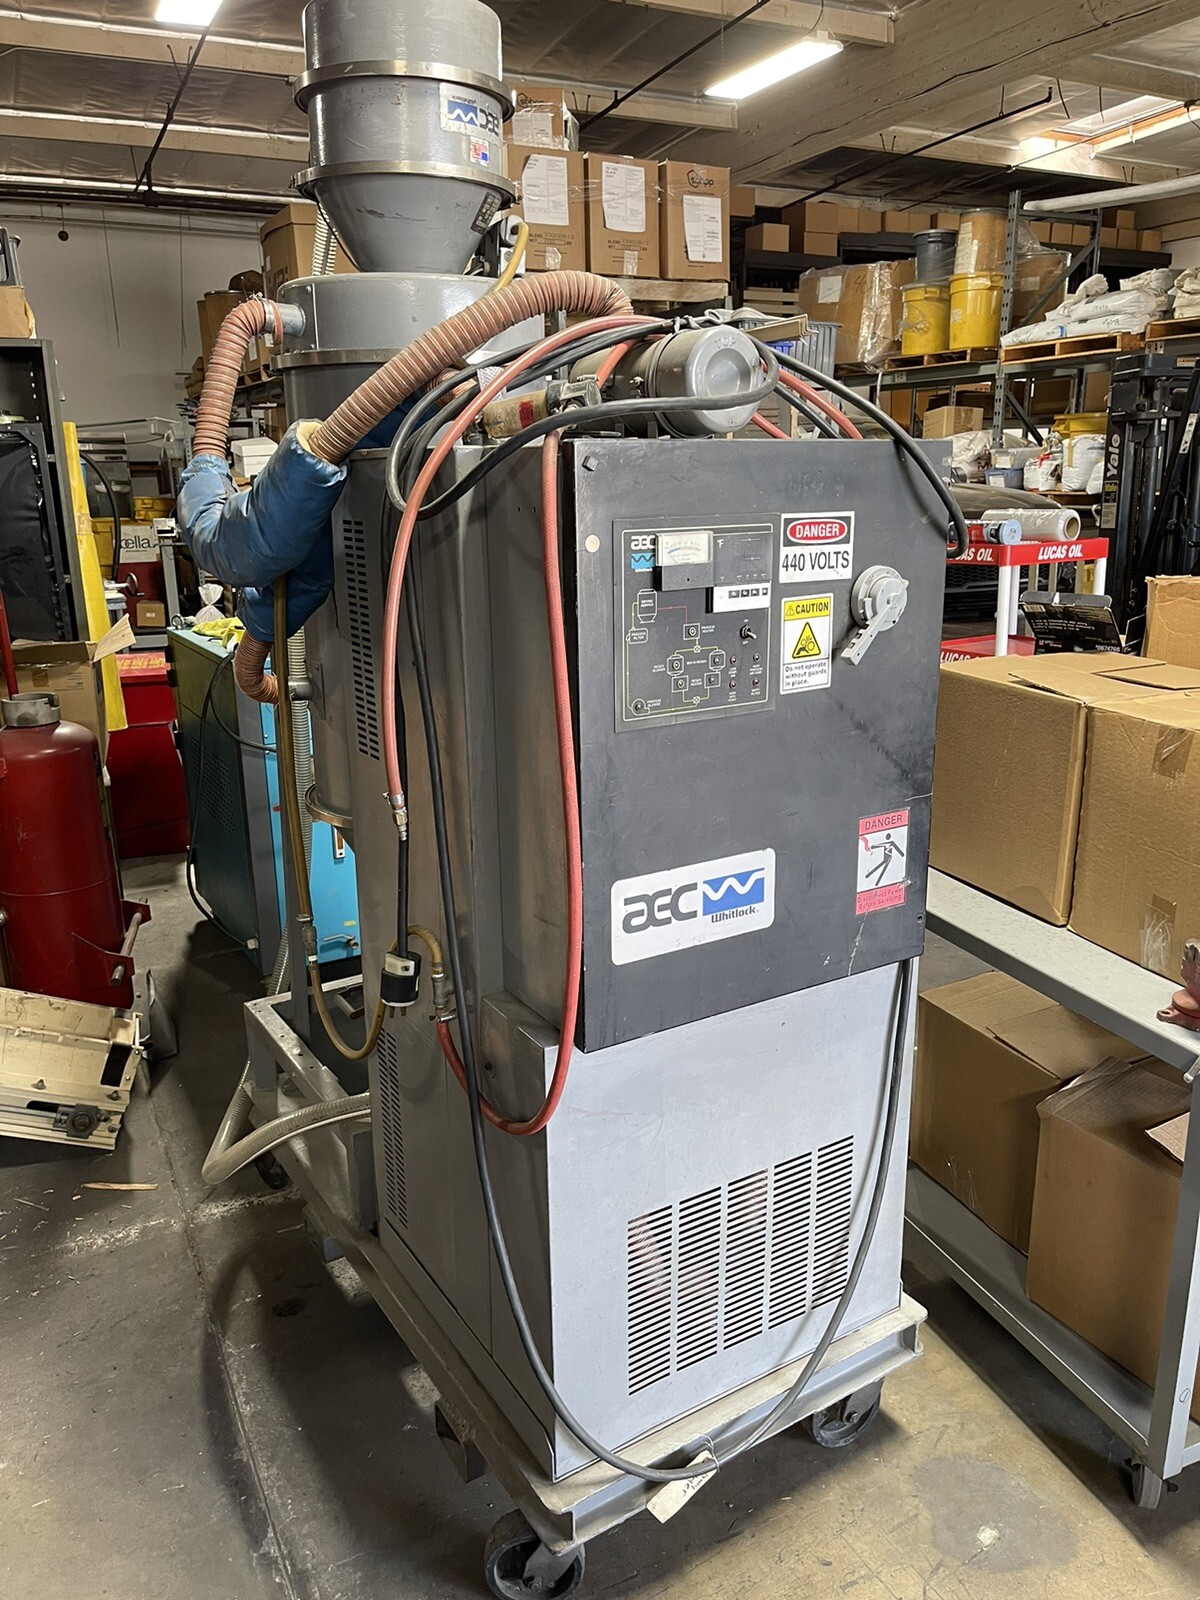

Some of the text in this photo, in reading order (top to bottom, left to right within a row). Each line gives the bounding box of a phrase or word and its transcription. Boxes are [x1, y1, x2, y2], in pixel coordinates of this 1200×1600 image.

[1106, 433, 1121, 478] Yale
[795, 523, 840, 538] DANGER
[976, 548, 994, 562] OIL
[1037, 544, 1084, 560] LUCAS OIL
[782, 550, 850, 572] 440 VOLTS
[795, 601, 829, 615] CAUTION
[805, 661, 827, 671] operate
[785, 668, 827, 680] without guards
[792, 679, 809, 687] place.
[865, 814, 903, 830] DANGER
[711, 905, 757, 924] Whitlock
